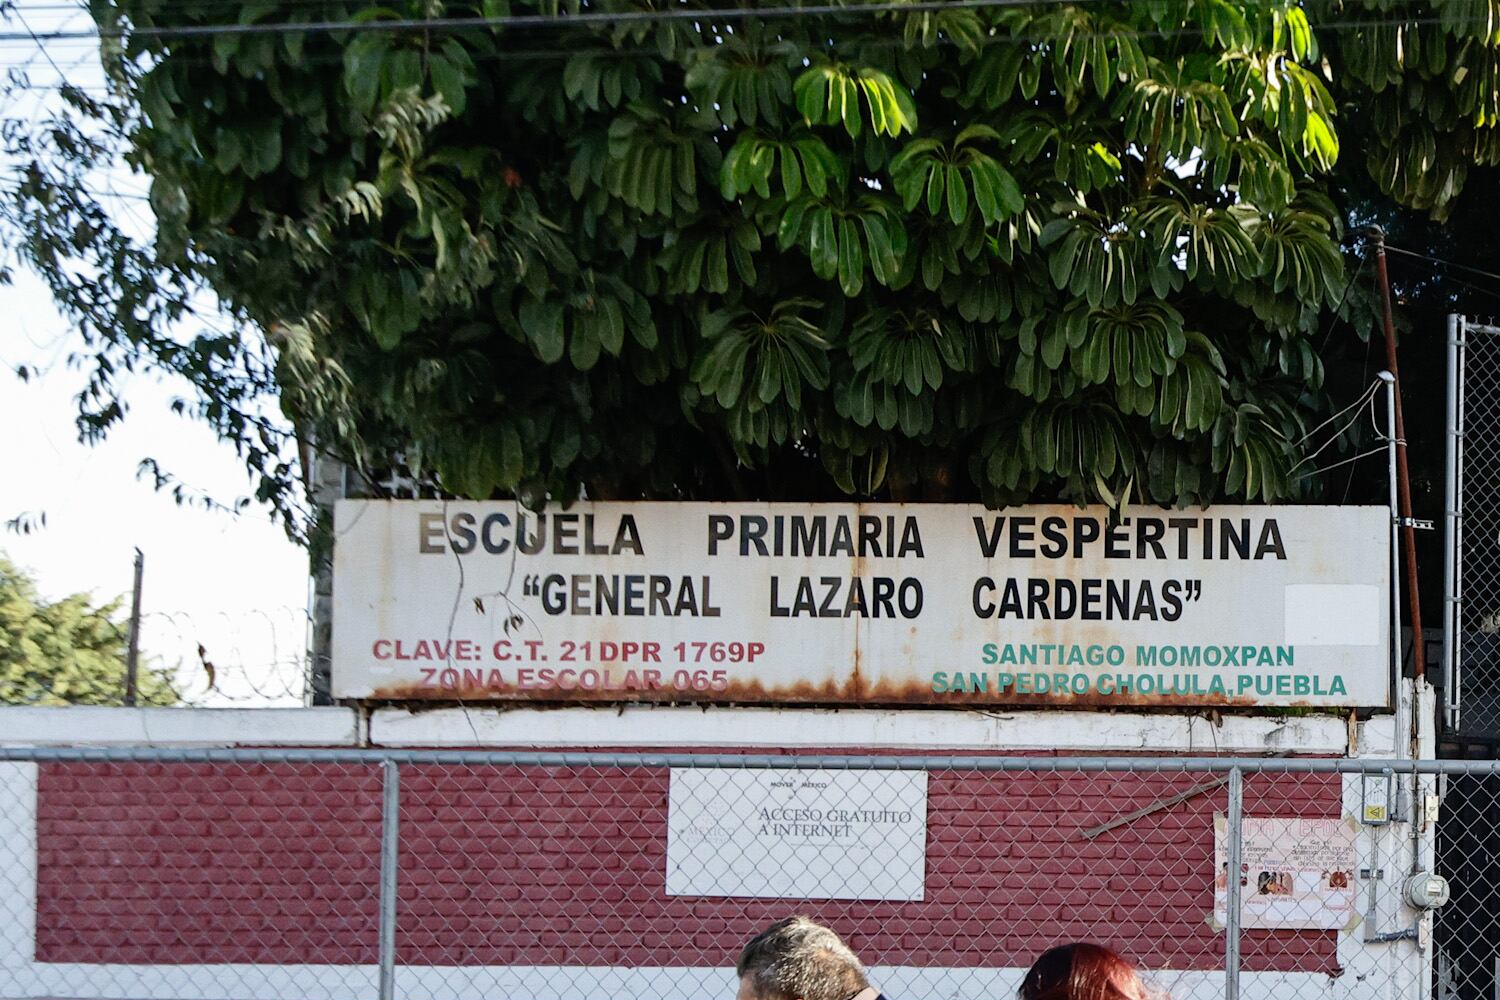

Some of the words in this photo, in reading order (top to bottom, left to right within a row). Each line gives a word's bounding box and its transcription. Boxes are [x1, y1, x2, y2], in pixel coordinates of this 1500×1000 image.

[419, 512, 645, 556] ESCUELA
[707, 514, 924, 558] PRIMARIA
[972, 516, 1287, 561] VESPERTINA
[769, 575, 924, 619] LAZARO
[372, 639, 481, 662] CLAVE:
[493, 640, 547, 663] C.T.
[673, 641, 766, 664] 1769P
[981, 643, 1125, 667] SANTIAGO
[1136, 645, 1295, 668] MOMOXPAN
[419, 668, 503, 690] ZONA
[517, 668, 662, 692] ESCOLAR
[673, 669, 728, 692] 065
[931, 671, 993, 694] SAN
[998, 672, 1090, 696] PEDRO
[758, 806, 822, 823] ACCESO
[826, 809, 912, 824] GRATUITO
[758, 823, 768, 836] A
[773, 823, 853, 838] INTERNET
